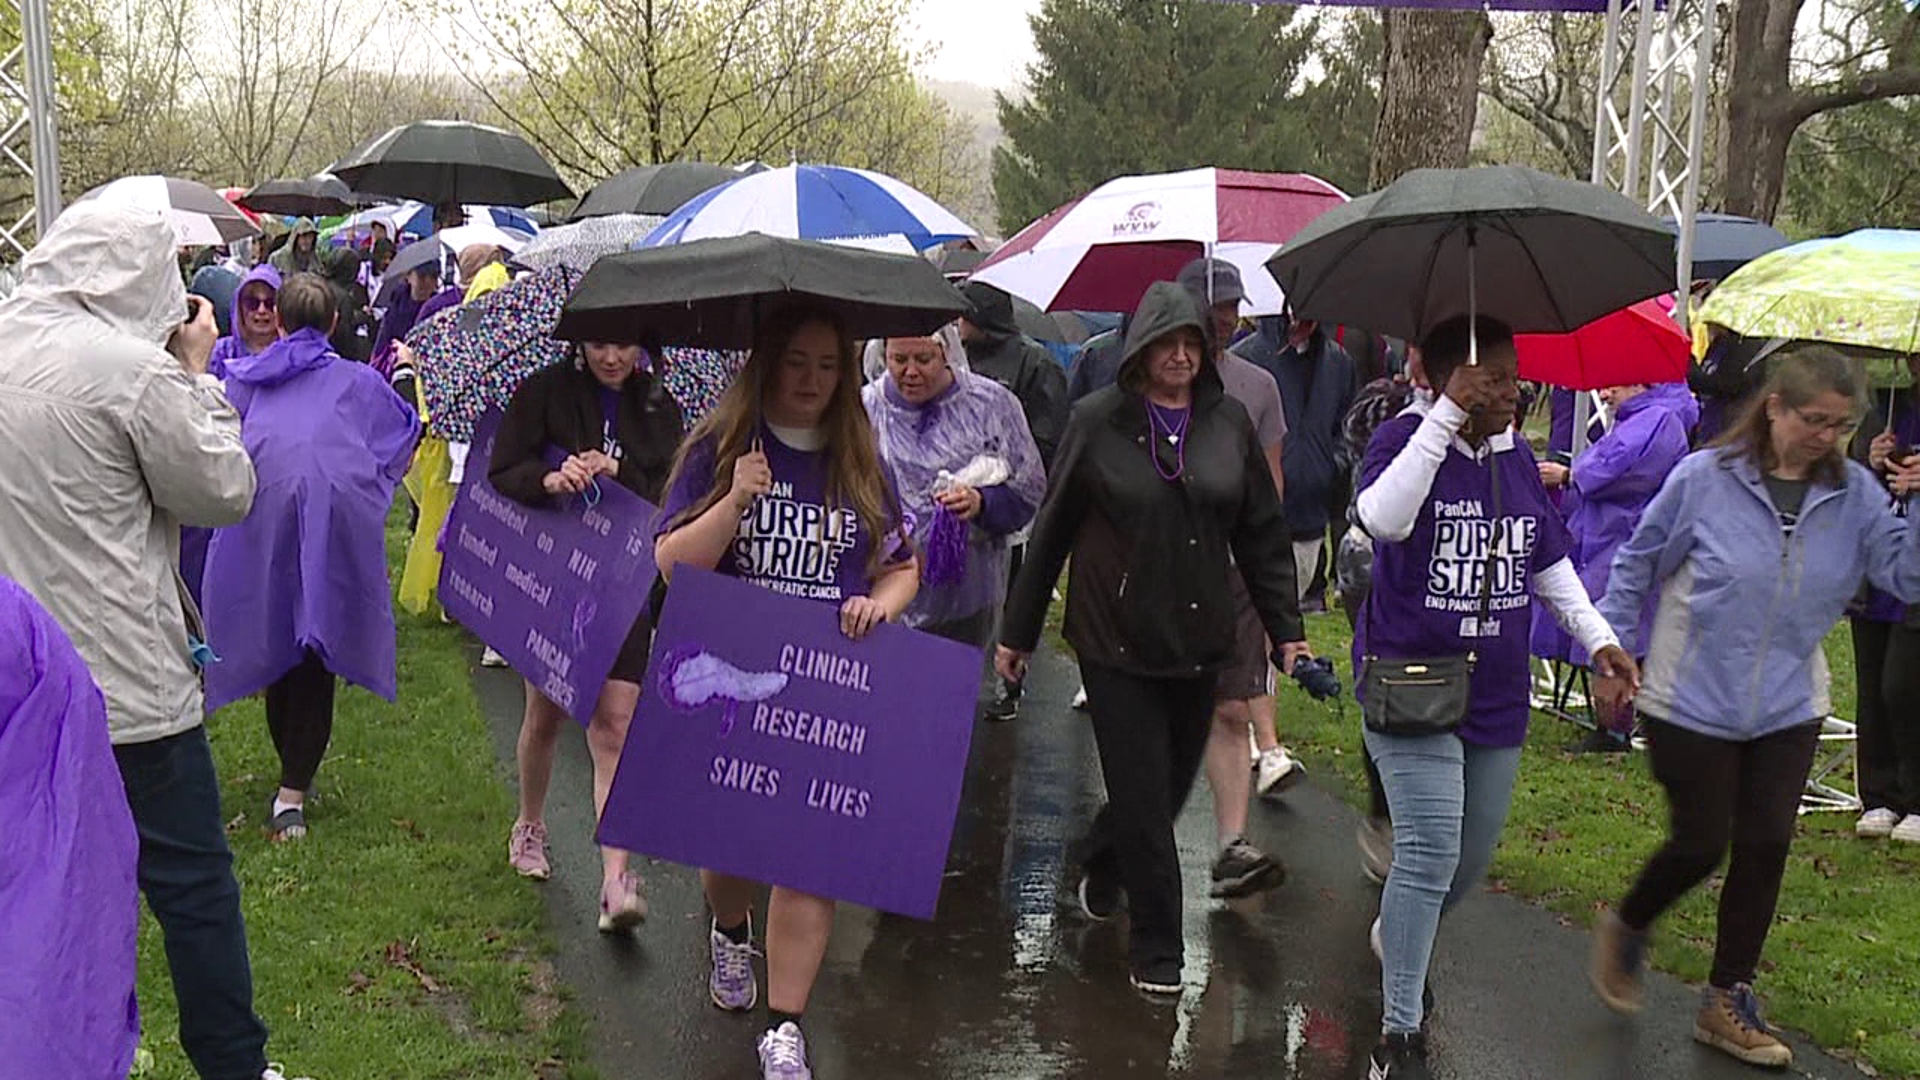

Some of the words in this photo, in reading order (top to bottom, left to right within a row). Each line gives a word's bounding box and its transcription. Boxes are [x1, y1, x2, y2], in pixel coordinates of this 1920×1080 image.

[470, 481, 528, 537] dependent
[537, 532, 553, 554] on
[568, 549, 597, 582] NIH
[582, 505, 611, 536] love
[626, 528, 642, 556] is
[1435, 500, 1483, 518] PanCAN
[459, 523, 498, 567] funded
[505, 563, 552, 608] medical
[733, 534, 845, 583] STRIDE
[1428, 555, 1526, 597] STRDE
[450, 570, 493, 619] research
[1425, 594, 1447, 610] END
[526, 628, 573, 677] PANCAN
[779, 644, 871, 692] CLINICAL
[544, 675, 576, 706] 2025
[753, 702, 866, 755] RESEARCH
[710, 756, 781, 797] SAVES
[807, 779, 871, 819] LIVES
